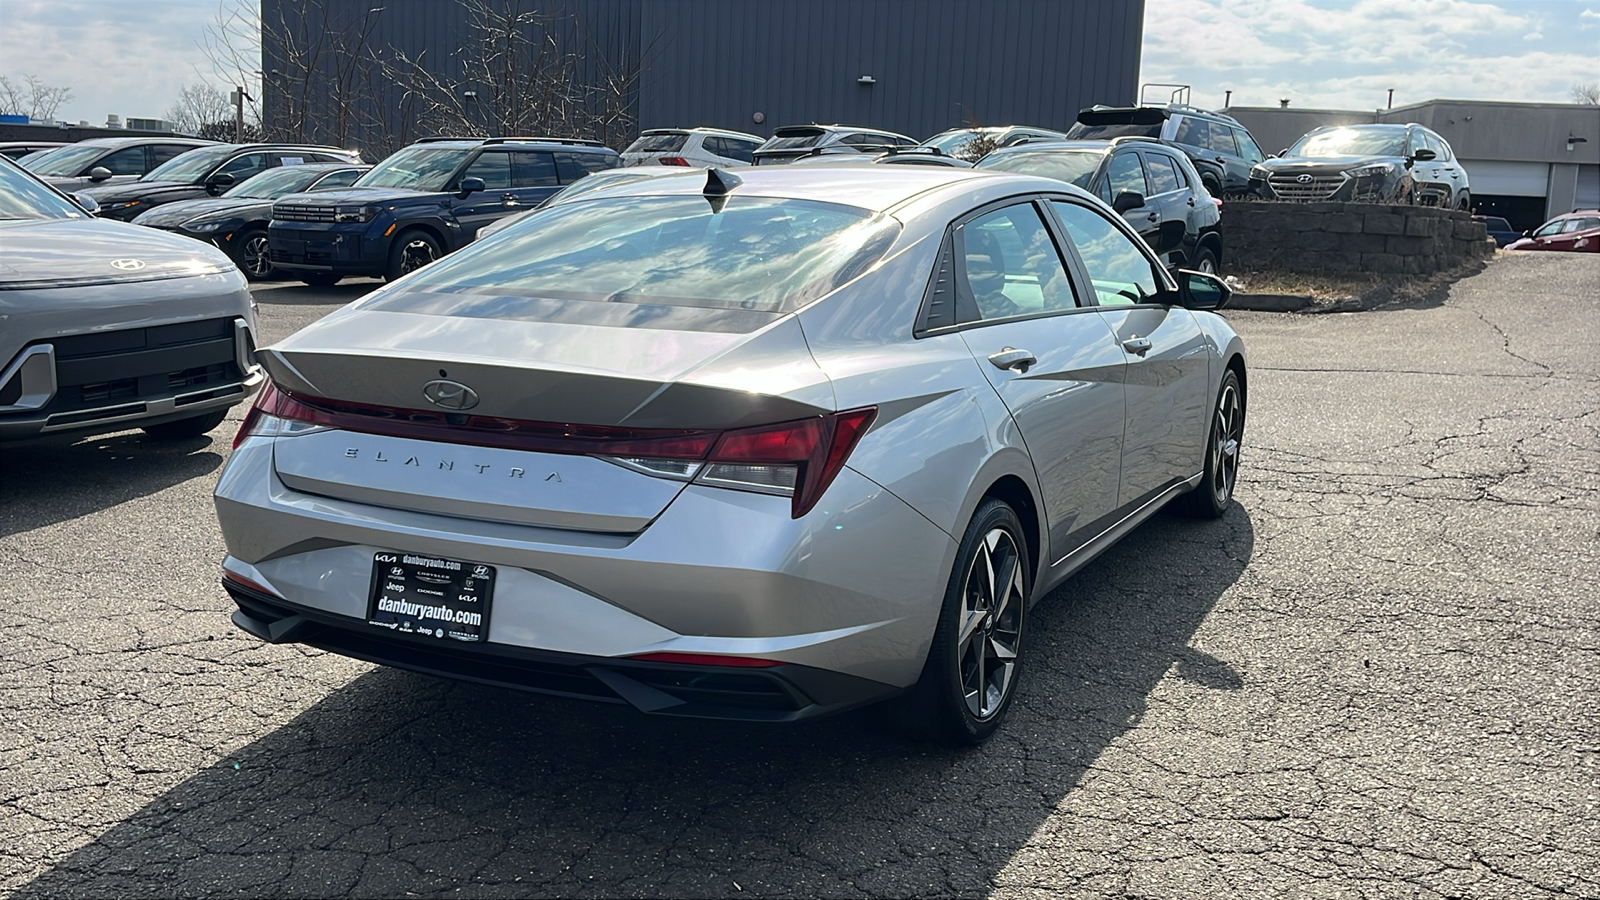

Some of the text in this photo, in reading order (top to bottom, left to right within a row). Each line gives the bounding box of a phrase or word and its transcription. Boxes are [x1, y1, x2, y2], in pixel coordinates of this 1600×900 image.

[344, 447, 562, 482] ELANTRA
[375, 554, 397, 563] KIA
[402, 554, 461, 571] danburyauto.com
[386, 582, 405, 593] Jeep
[458, 594, 478, 602] KIA
[378, 595, 482, 626] danburyauto.com
[416, 626, 433, 636] Jeep
